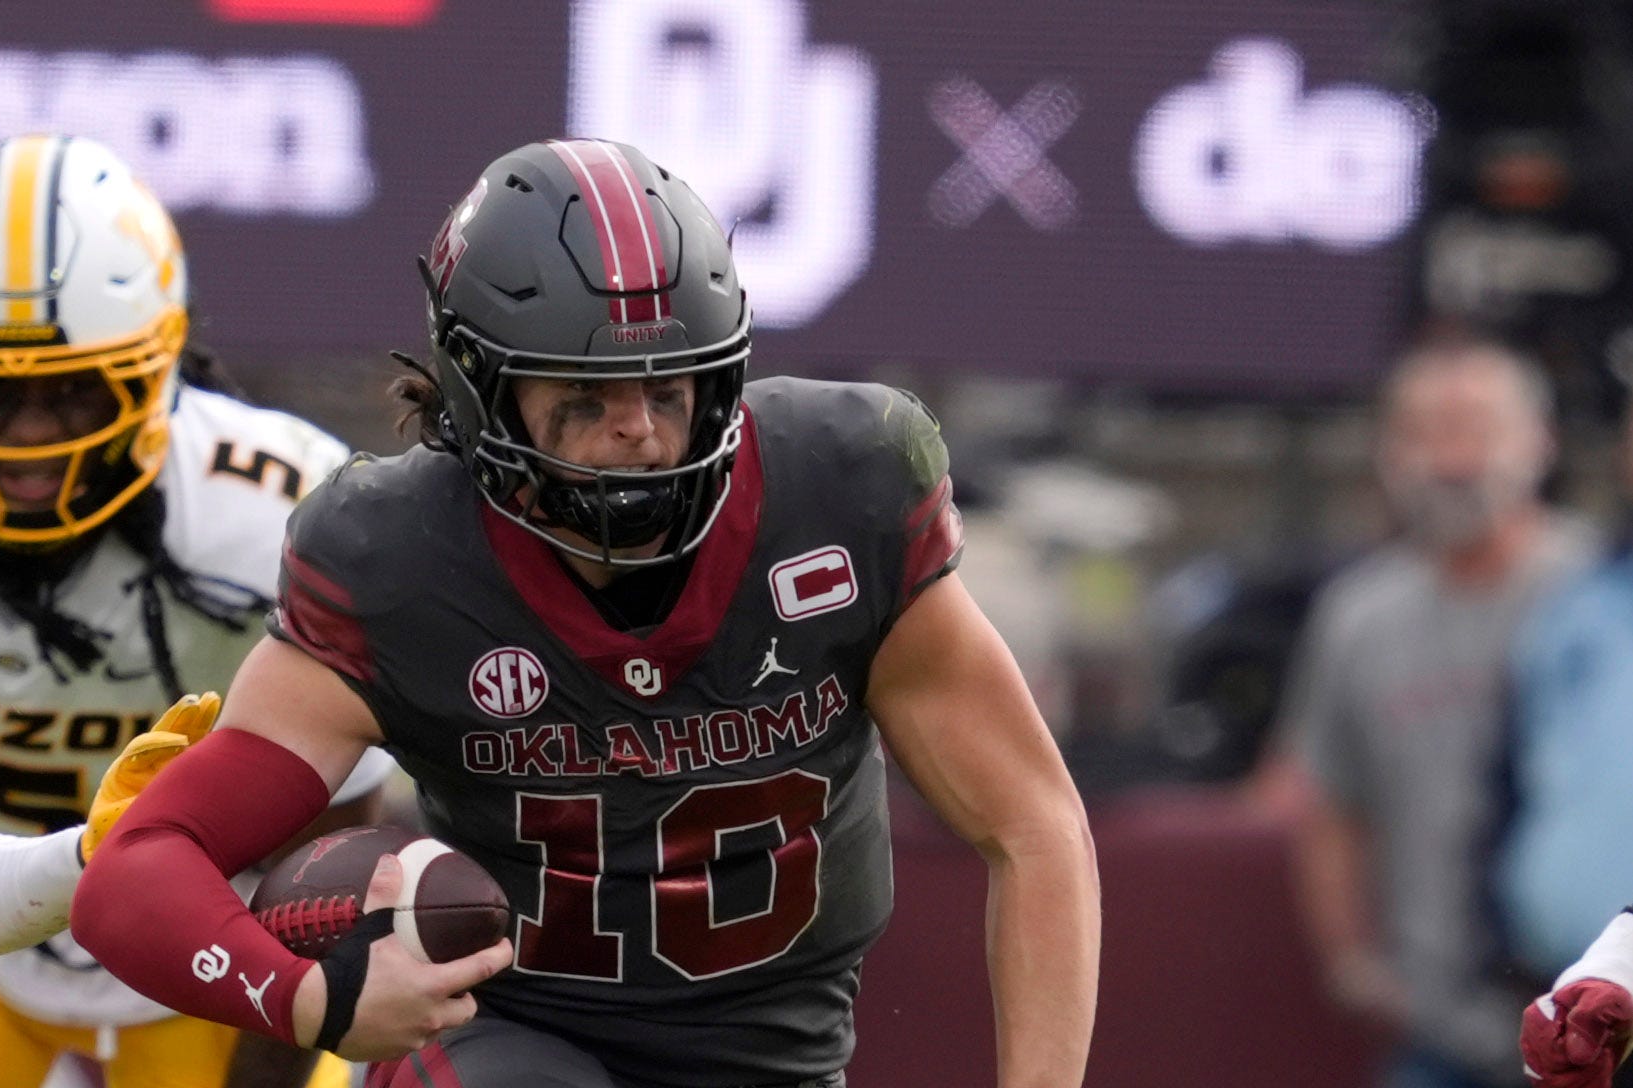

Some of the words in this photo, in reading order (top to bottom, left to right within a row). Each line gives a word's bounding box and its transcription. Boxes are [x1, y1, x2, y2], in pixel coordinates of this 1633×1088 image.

[612, 325, 666, 344] UNITY
[209, 439, 303, 503] 5
[769, 545, 858, 622] C
[471, 649, 547, 717] SEC
[623, 657, 663, 698] OU
[462, 673, 849, 778] OKLAHOMA
[513, 767, 830, 983] 10
[191, 943, 231, 984] OU
